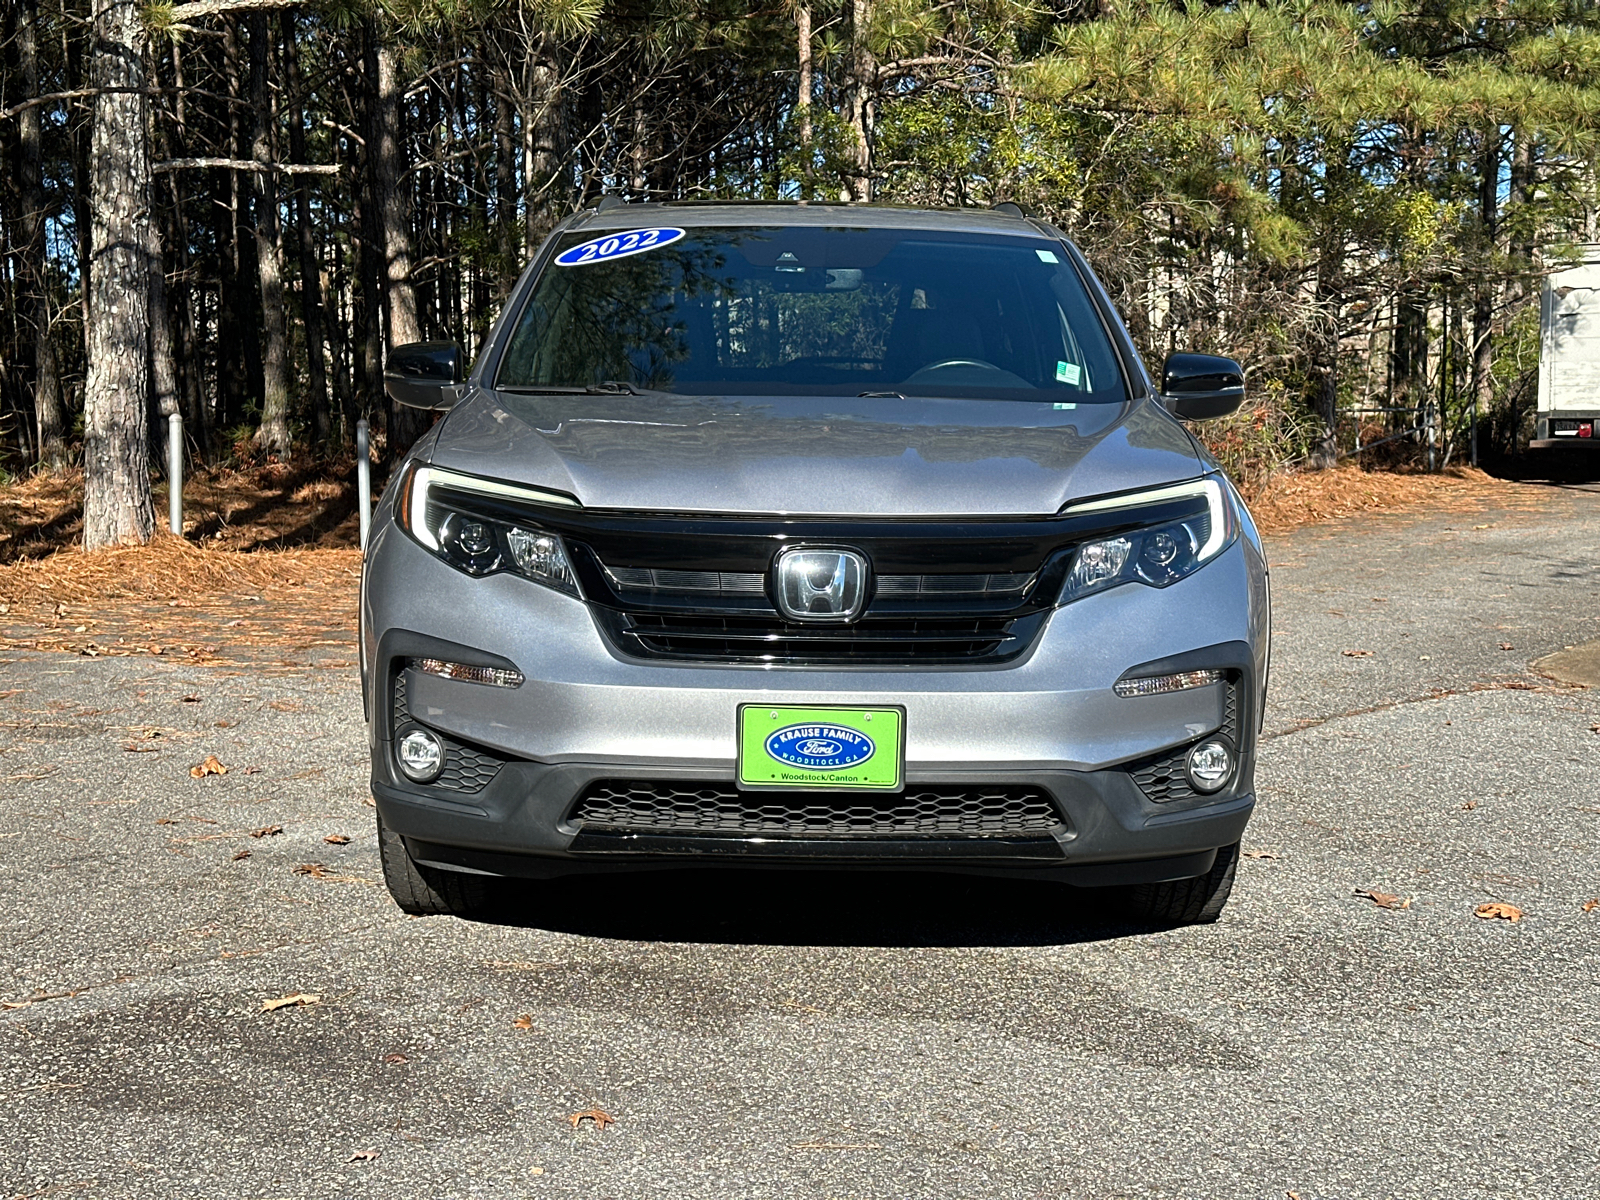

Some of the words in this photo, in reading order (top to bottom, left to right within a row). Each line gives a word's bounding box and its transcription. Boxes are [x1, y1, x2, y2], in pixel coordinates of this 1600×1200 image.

[577, 230, 660, 262] 2022
[779, 728, 820, 743] KRAUSE
[823, 728, 862, 745] FAMILY
[803, 740, 835, 754] Ford
[845, 754, 859, 763] GA
[781, 773, 858, 782] Woodstock/Canton
